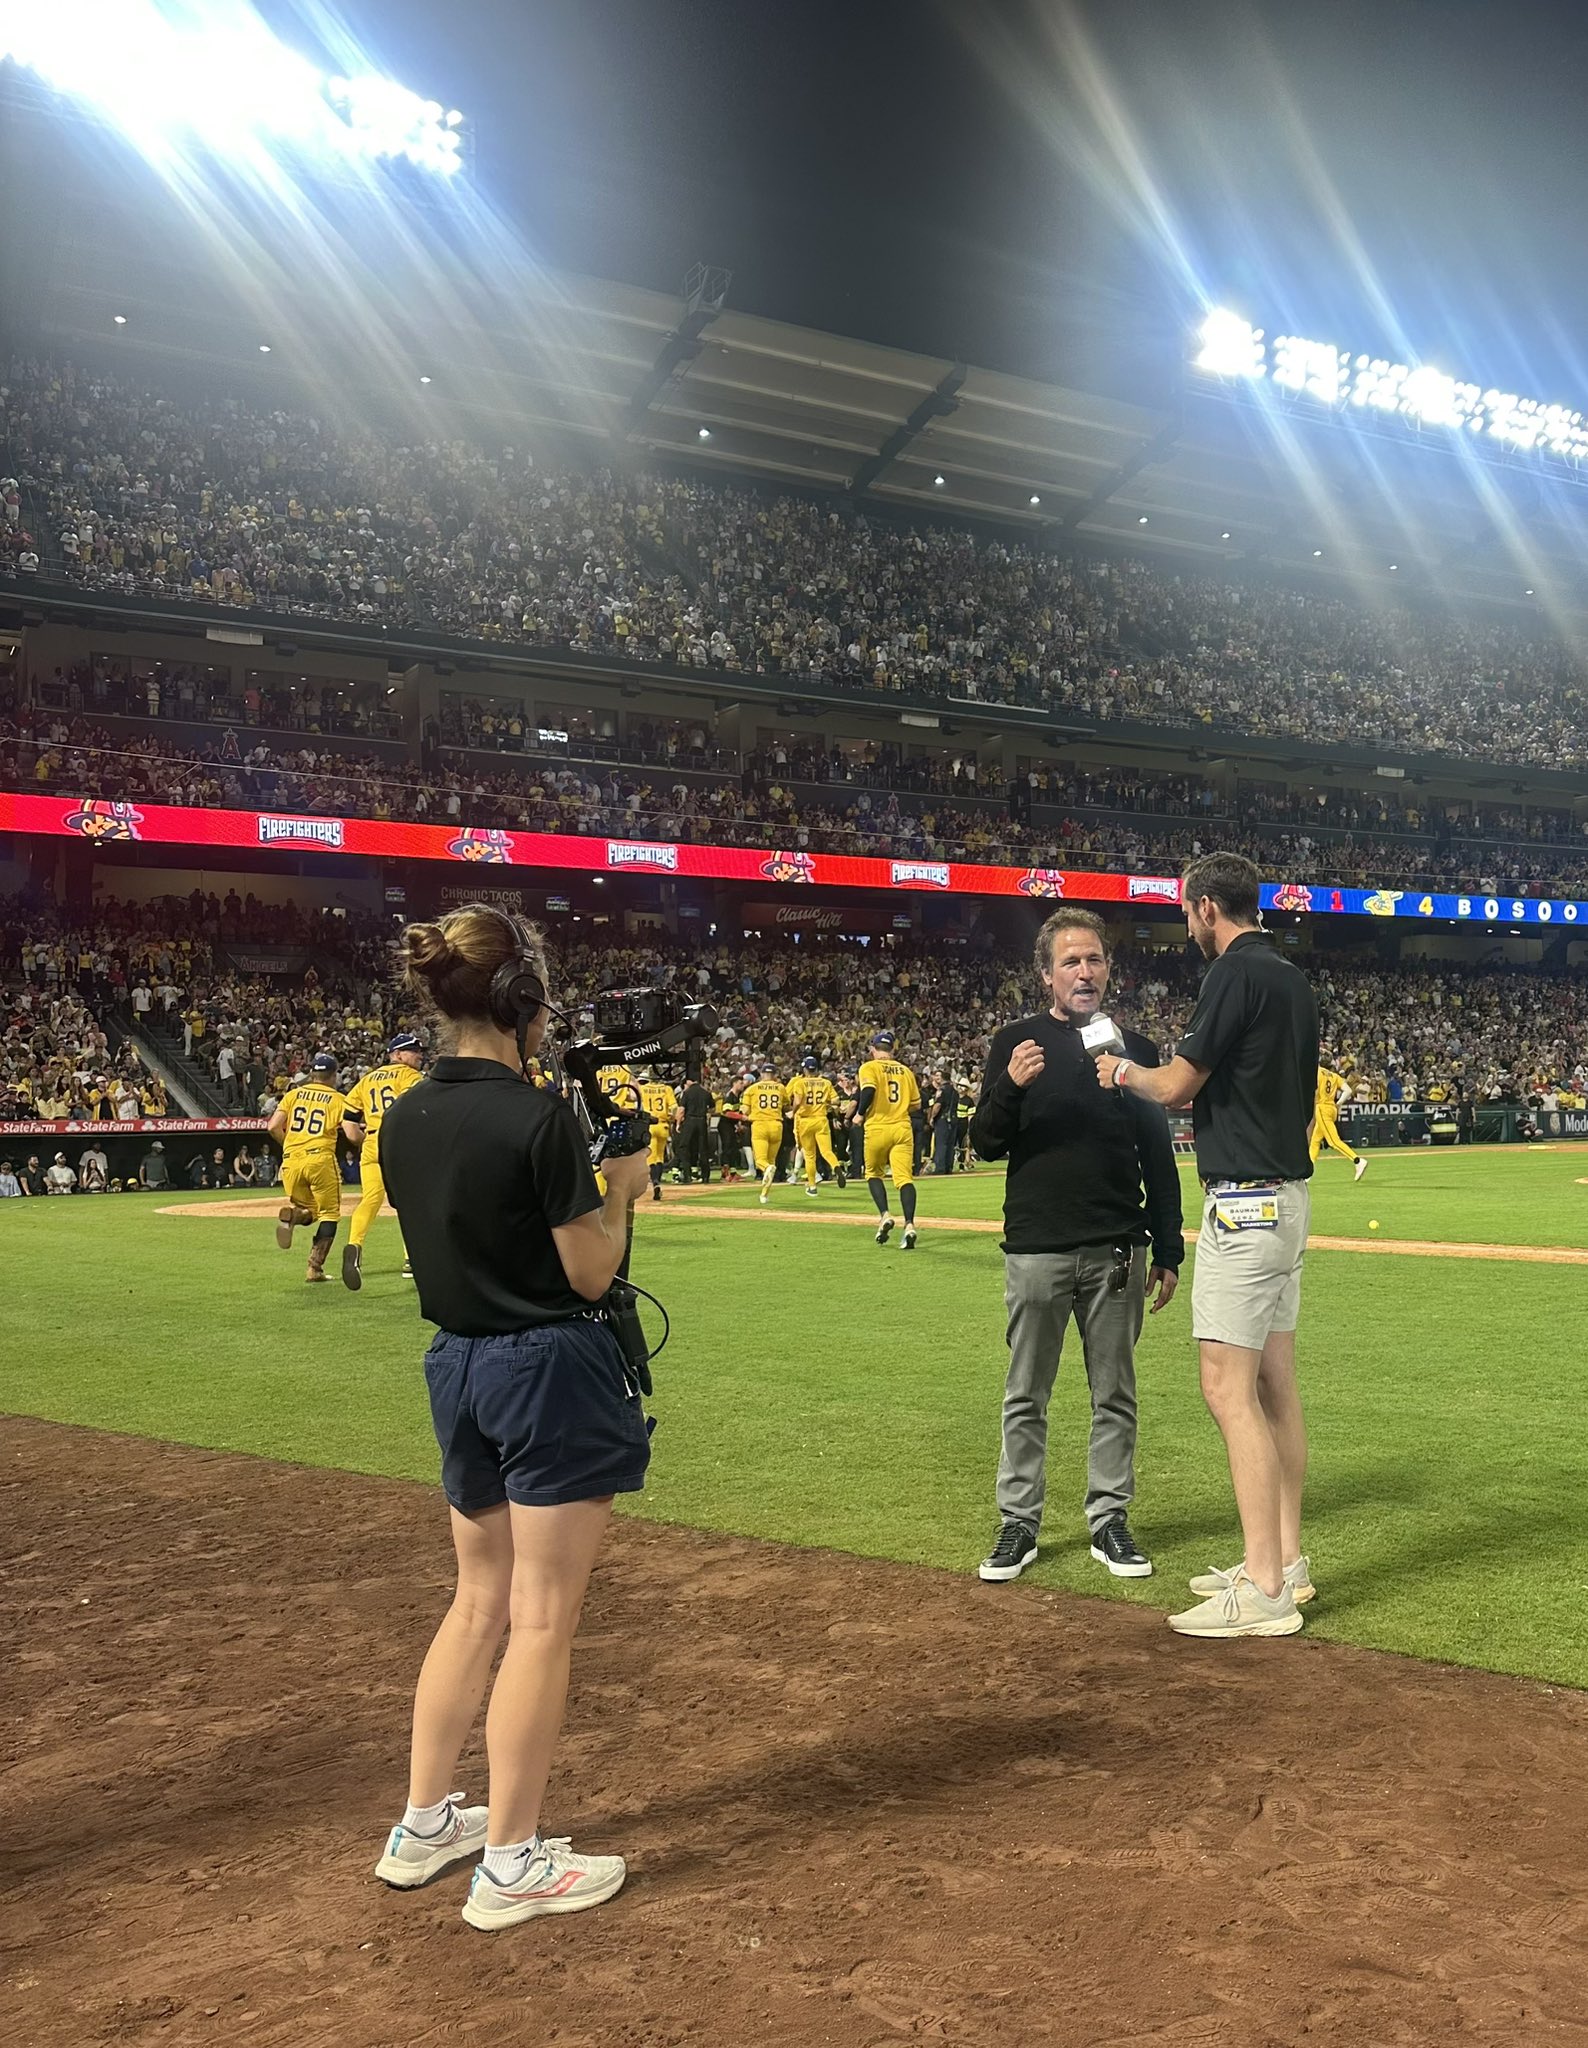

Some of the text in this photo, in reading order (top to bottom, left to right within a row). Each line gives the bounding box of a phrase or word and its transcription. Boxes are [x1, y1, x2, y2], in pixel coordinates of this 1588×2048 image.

[440, 886, 523, 906] CHRONIC TACOS
[1331, 890, 1344, 911] 1
[1418, 896, 1434, 916] 4
[1458, 899, 1471, 916] B
[1512, 901, 1525, 919] S
[775, 906, 821, 923] Classic
[623, 1041, 661, 1061] RONIN
[887, 1081, 900, 1103] 3
[1325, 1080, 1332, 1094] 8
[296, 1090, 333, 1105] GILLUM
[370, 1085, 396, 1113] 16
[648, 1097, 664, 1112] 13
[758, 1094, 780, 1109] 88
[806, 1091, 824, 1105] 22
[290, 1107, 326, 1135] 56
[1338, 1104, 1413, 1121] ETWORK
[230, 1119, 269, 1130] StateFa
